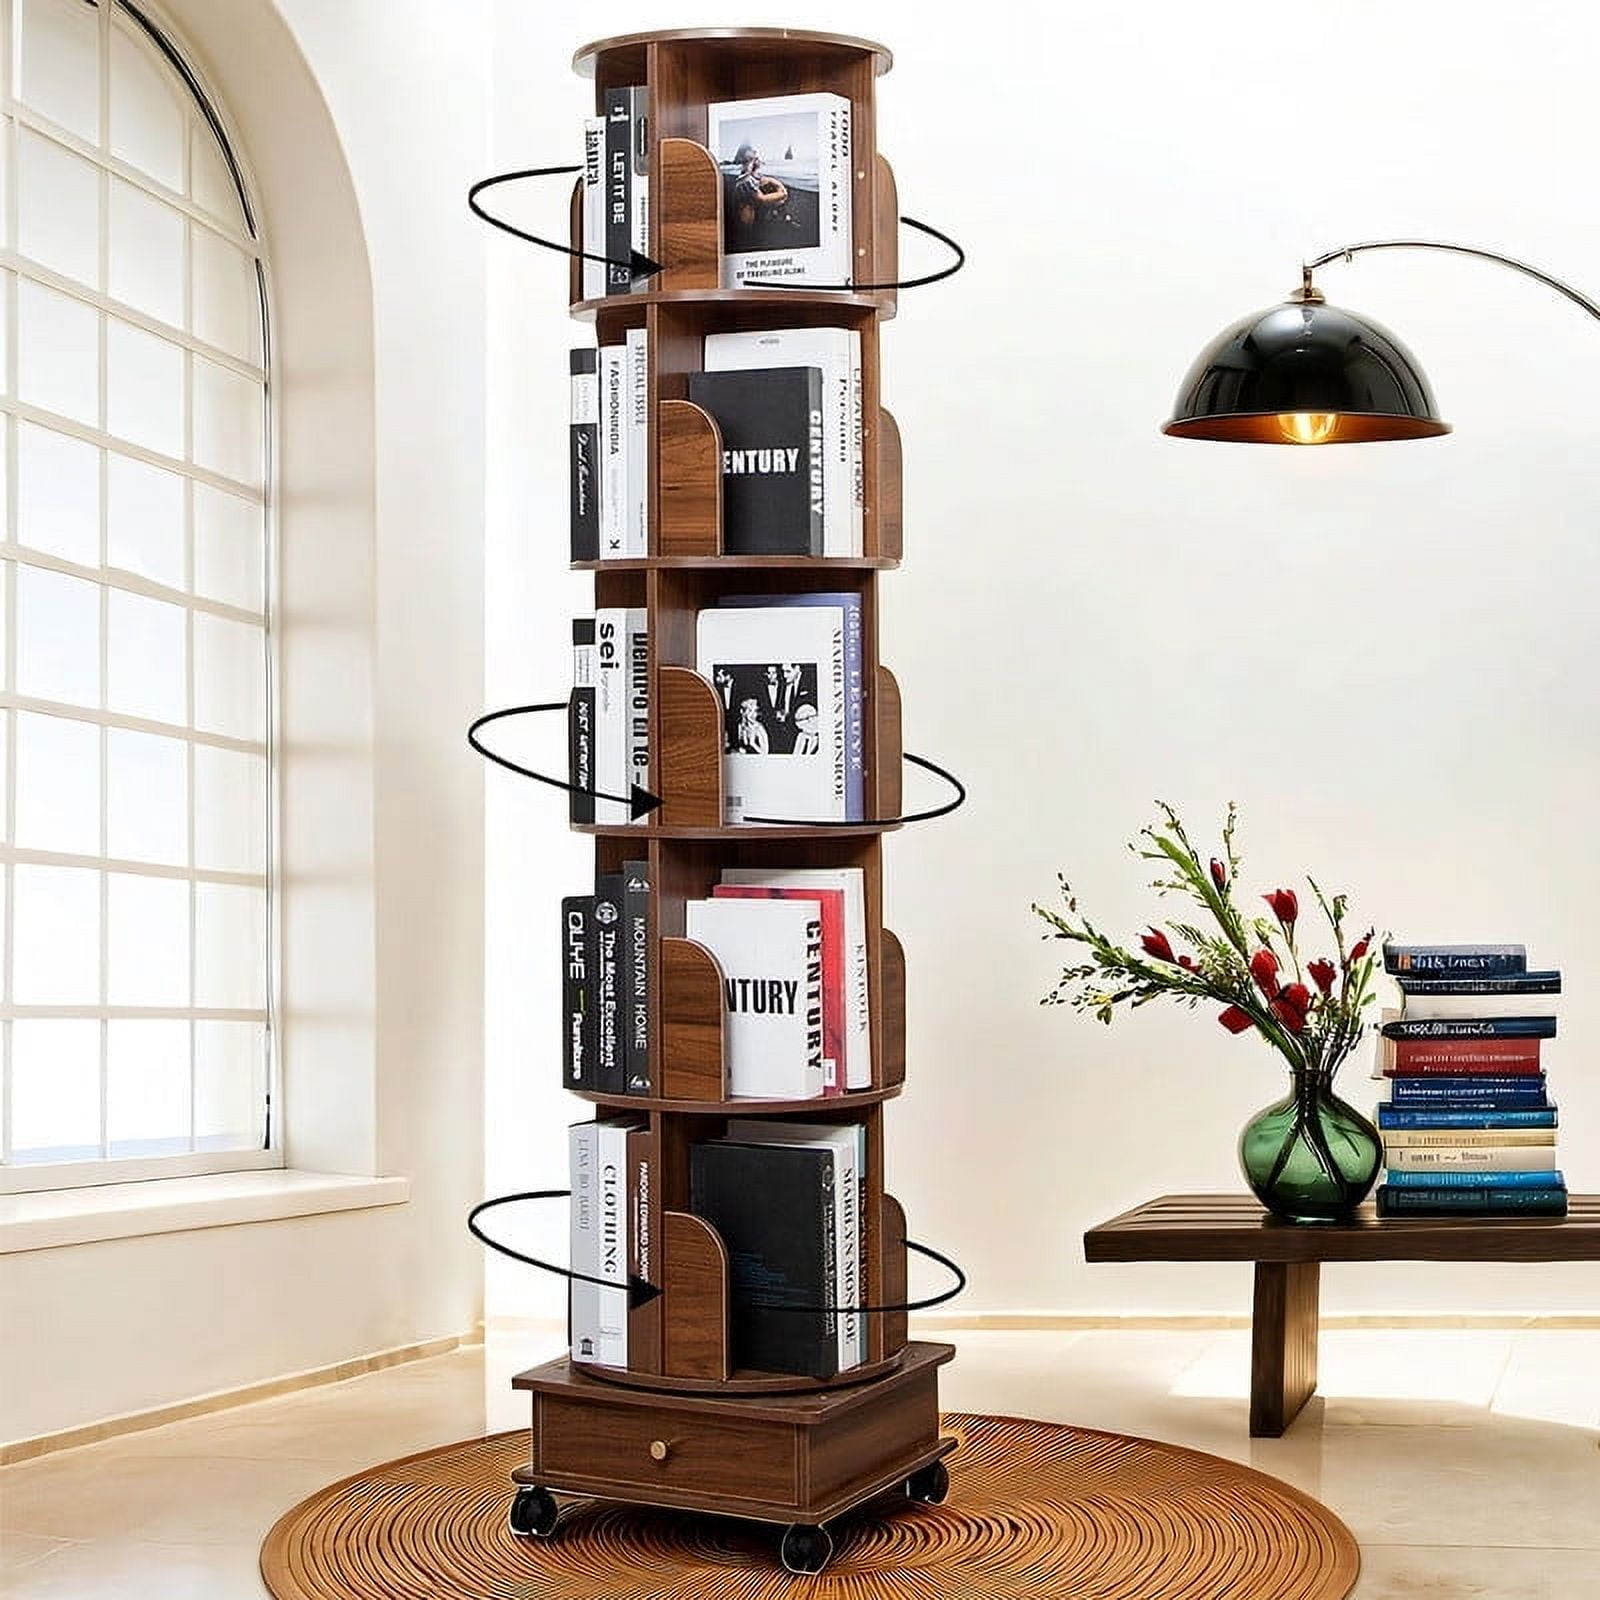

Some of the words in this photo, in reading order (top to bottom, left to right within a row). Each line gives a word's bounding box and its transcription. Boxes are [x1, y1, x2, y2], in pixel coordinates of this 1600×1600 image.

[612, 152, 625, 180] LET
[612, 183, 625, 199] IT
[612, 201, 625, 225] BE
[723, 448, 799, 474] ENTURY
[810, 409, 822, 515] CENTURY
[600, 623, 620, 669] sei
[833, 720, 844, 800] MONROE
[605, 930, 616, 958] The
[634, 917, 646, 996] MOUNTAIN
[605, 961, 616, 997] Most
[725, 978, 798, 1014] NTURY
[806, 920, 821, 1069] CENTURY
[635, 1004, 647, 1050] HOME
[604, 1165, 617, 1273] CLOTHING
